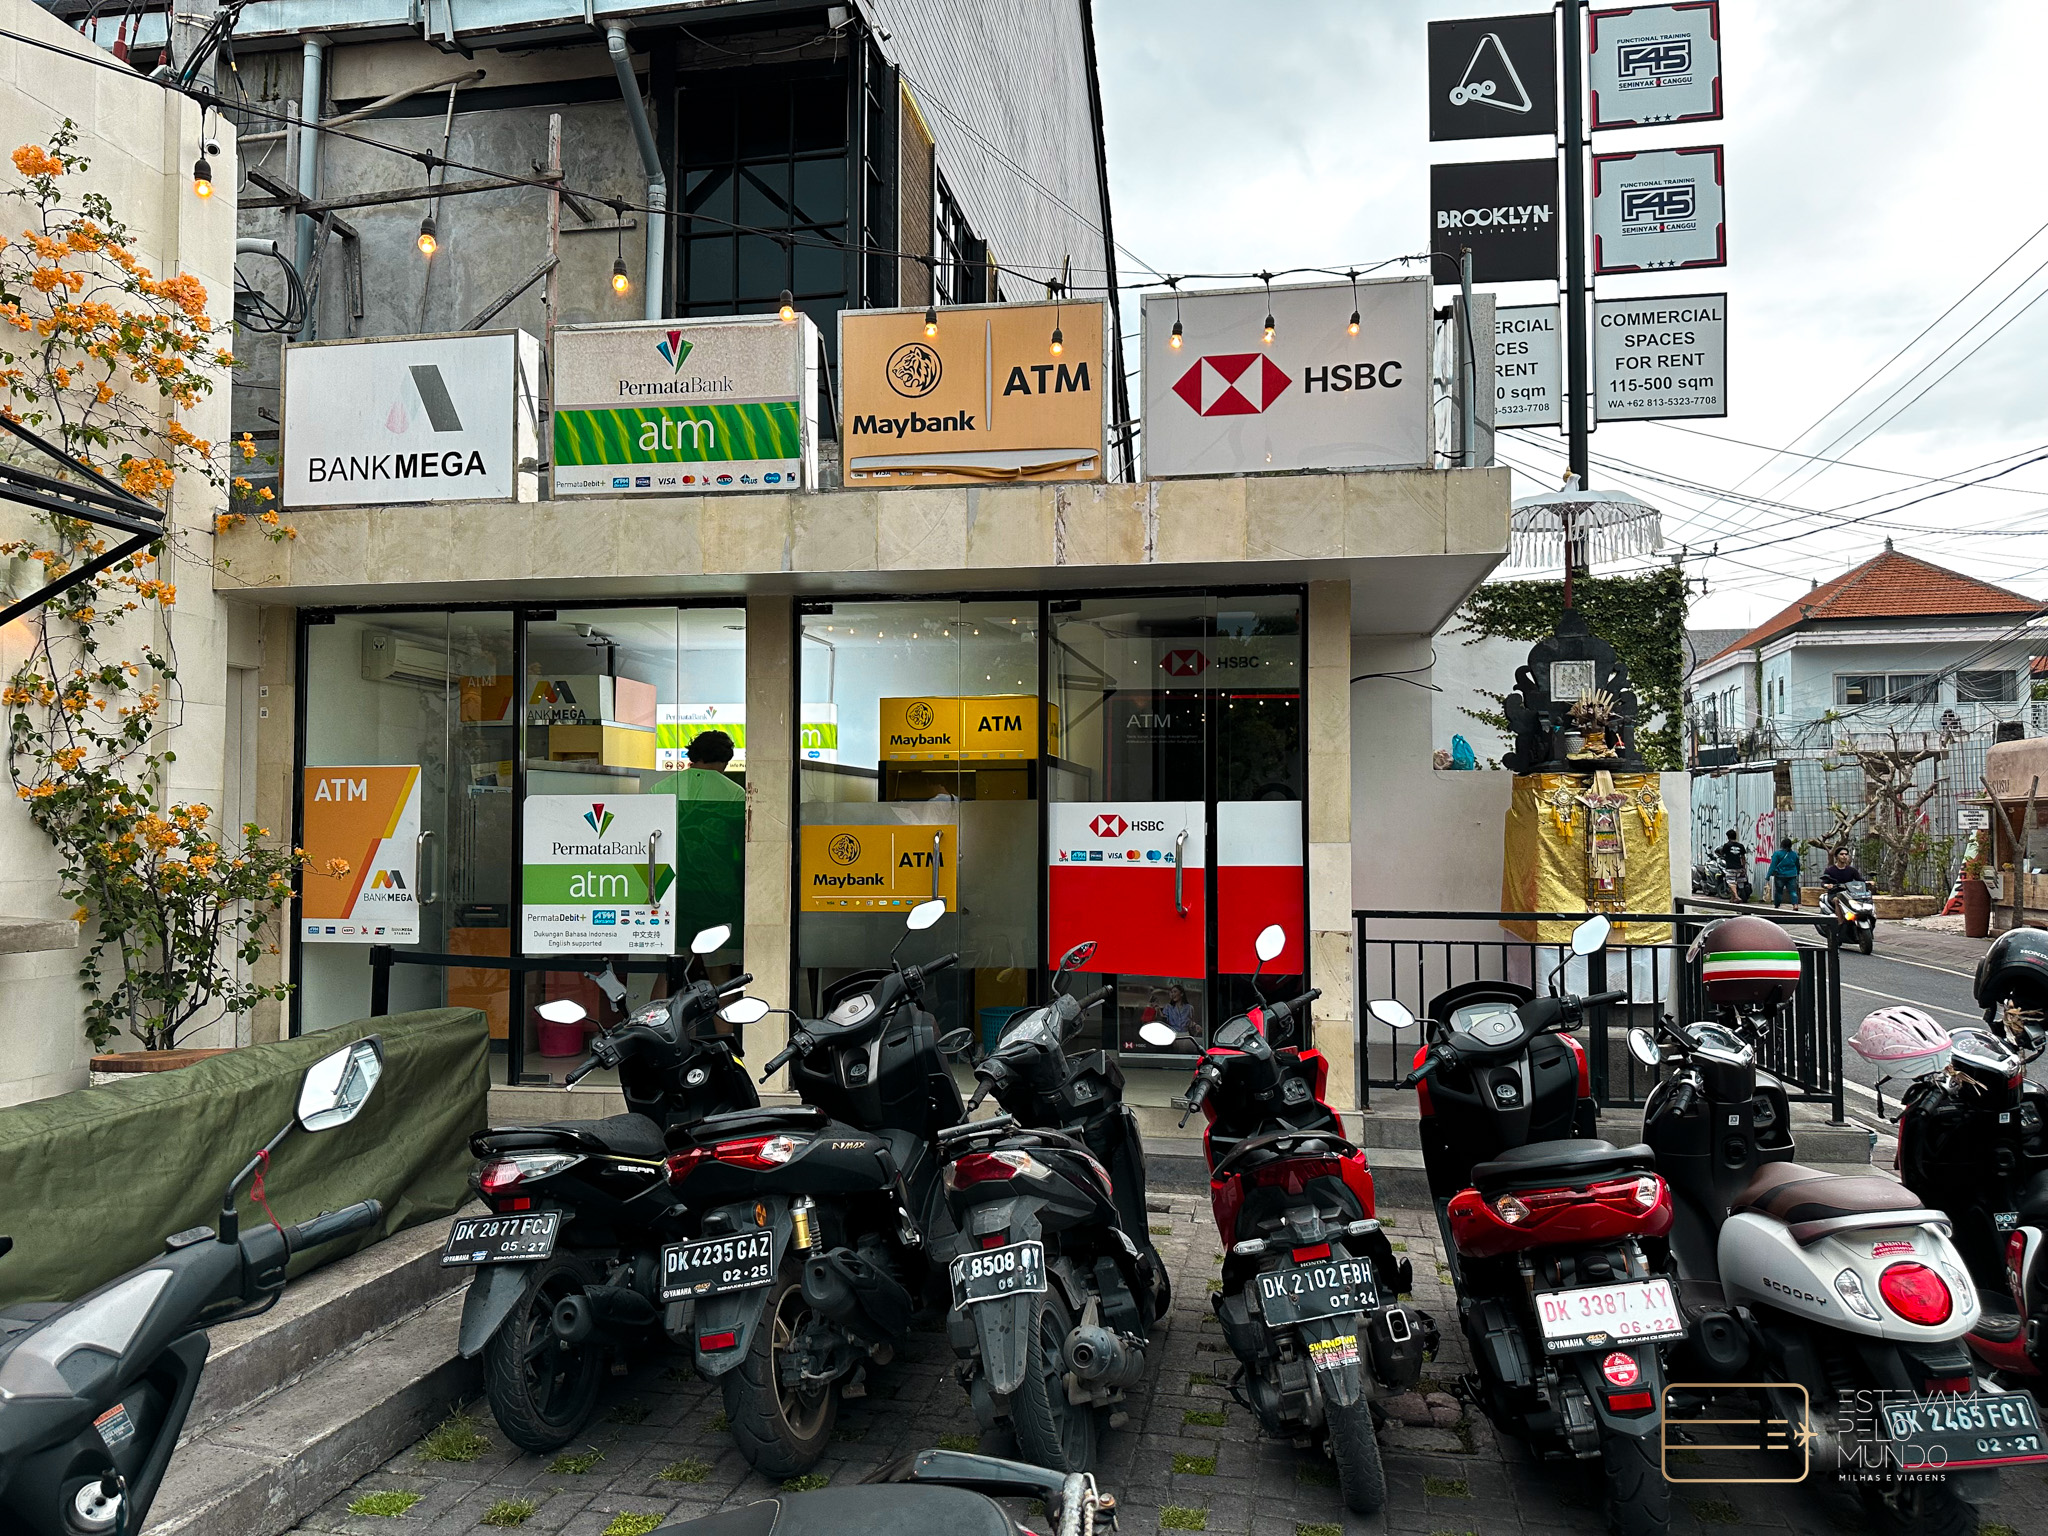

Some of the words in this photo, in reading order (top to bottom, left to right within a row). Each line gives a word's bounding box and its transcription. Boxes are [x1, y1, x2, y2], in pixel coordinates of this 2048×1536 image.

[1617, 36, 1658, 44] FUNCTIONAL
[1620, 41, 1690, 75] F45
[1619, 80, 1654, 89] SEMINYAK
[1662, 77, 1692, 85] CANGGU
[1620, 181, 1662, 189] FUNCTIONAL
[1623, 186, 1693, 220] F45
[1437, 204, 1550, 229] BROOKLYN
[1448, 226, 1538, 236] BILLIARDS
[1622, 225, 1658, 233] SEMINYAK
[1666, 222, 1696, 230] CANGGU
[1600, 308, 1722, 327] COMMERCIAL
[1495, 318, 1554, 334] ERCIAL
[1624, 331, 1695, 348] SPACES
[1495, 341, 1529, 356] CES
[1615, 356, 1652, 370] FOR
[1657, 352, 1705, 368] RENT
[1003, 363, 1091, 396] ATM
[1304, 361, 1403, 393] HSBC
[1610, 376, 1673, 393] 115-500
[1678, 376, 1714, 391] sqm
[619, 376, 734, 397] PermataBank
[1511, 386, 1546, 401] sqm
[1495, 403, 1550, 415] 3-5323-7708
[1608, 400, 1625, 408] WA
[1627, 399, 1644, 407] +62
[1647, 396, 1717, 407] 813-5323-7708
[852, 411, 976, 438] Maybank
[638, 416, 715, 451] atm
[658, 477, 676, 486] VISA
[1217, 656, 1260, 669] HSBC
[527, 709, 586, 720] ANKMEGA
[1126, 714, 1171, 728] ATM
[978, 715, 1023, 732] ATM
[890, 733, 951, 747] Maybank
[314, 778, 368, 802] ATM
[1131, 821, 1165, 832] HSBC
[552, 841, 647, 857] PermataBank
[570, 871, 629, 899] atm
[813, 873, 885, 889] Maybank
[363, 892, 413, 902] BANKMEGA
[533, 931, 563, 939] Dukungan
[548, 940, 570, 948] English
[572, 940, 602, 948] supported
[832, 1141, 866, 1150] NMAX
[618, 1165, 655, 1174] GEAR
[456, 1223, 478, 1241] DK
[479, 1219, 520, 1238] 2877
[520, 1218, 553, 1235] FCJ
[668, 1250, 689, 1273] DK
[691, 1242, 734, 1268] 4235
[737, 1237, 769, 1260] GAZ
[971, 1252, 1015, 1278] 8508
[1262, 1276, 1288, 1299] DK
[1291, 1268, 1340, 1294] 2102
[1340, 1263, 1372, 1285] FBH
[669, 1287, 692, 1298] YAMAHA
[1763, 1277, 1826, 1306] SCOOPY
[1544, 1299, 1571, 1322] DK
[1579, 1292, 1628, 1316] 3387
[1641, 1286, 1667, 1309] XY
[1555, 1338, 1584, 1349] YAMAHA
[1890, 1409, 1924, 1435] DK
[1927, 1406, 1985, 1431] 2465
